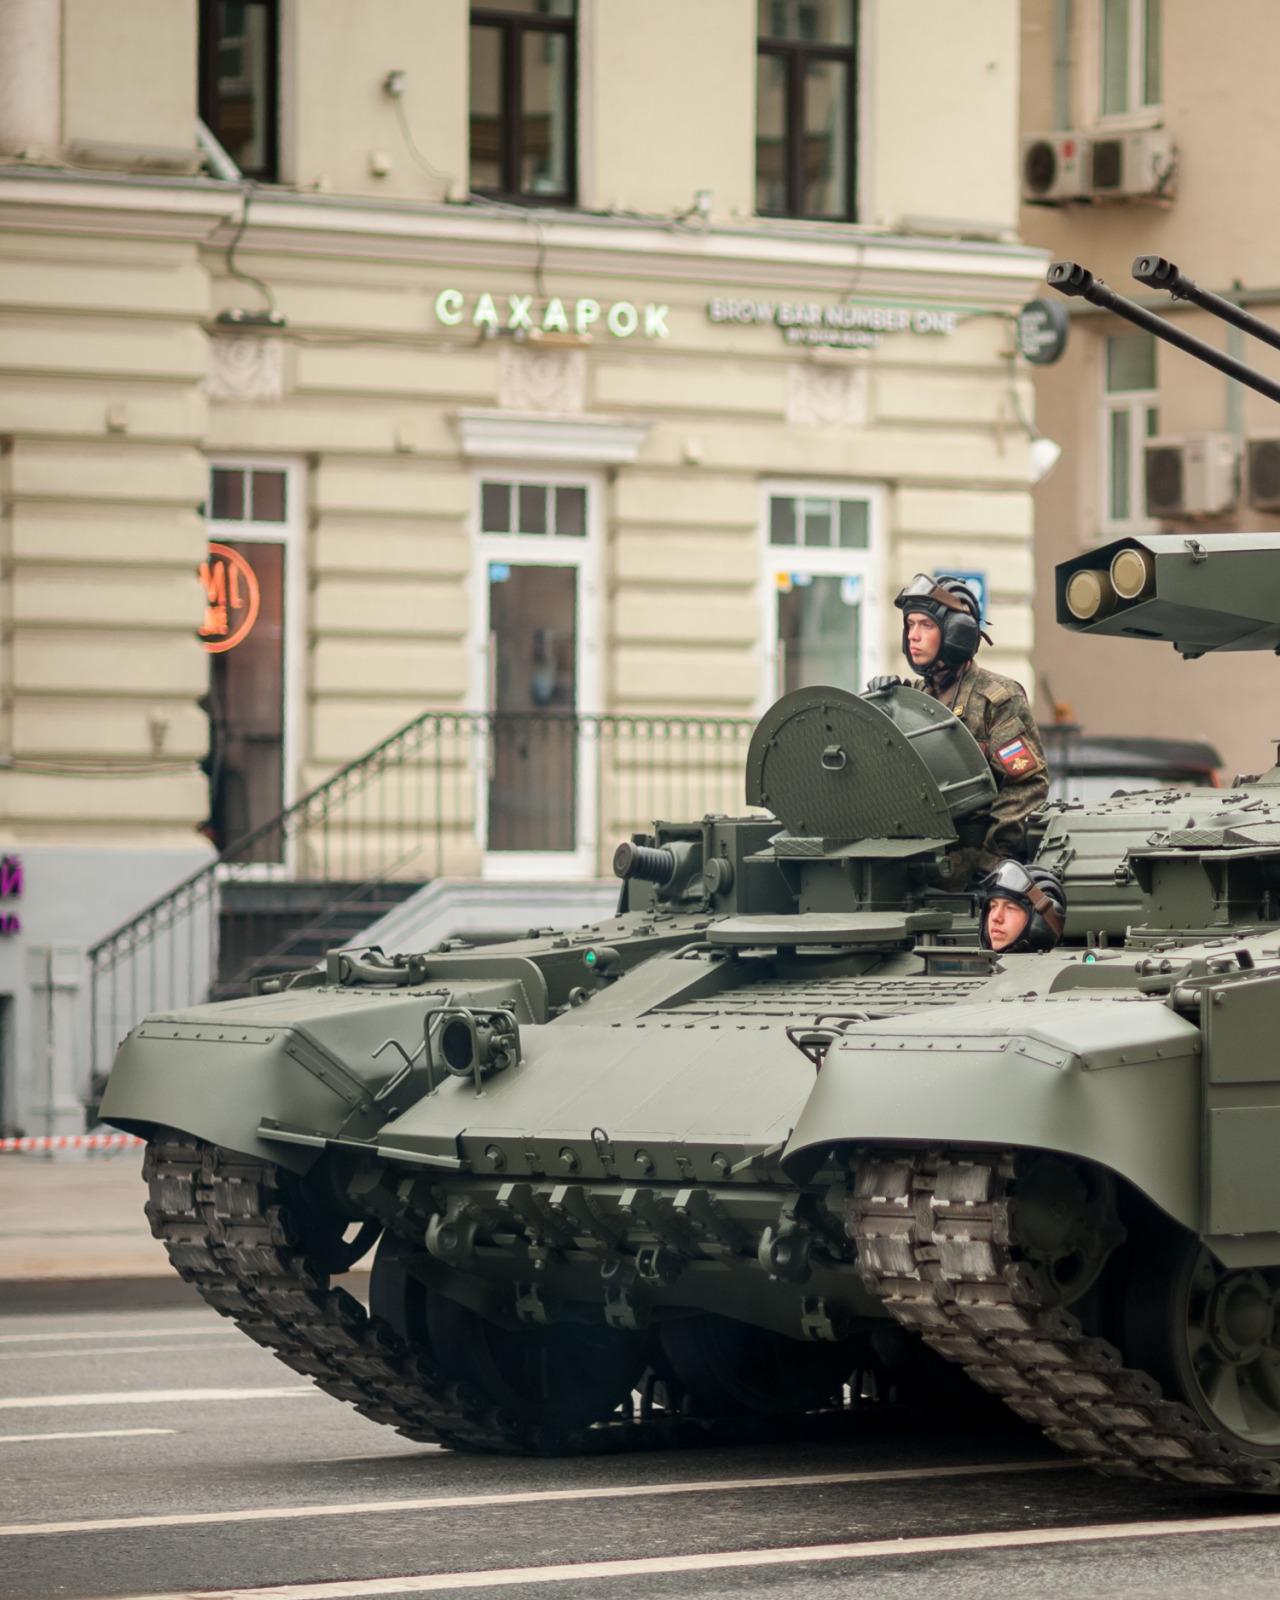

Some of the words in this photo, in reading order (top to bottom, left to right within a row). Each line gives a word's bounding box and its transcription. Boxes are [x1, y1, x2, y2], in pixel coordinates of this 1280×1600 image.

[435, 288, 670, 339] САХАРОК
[709, 298, 772, 322] BROW
[776, 303, 821, 327] BAR
[824, 306, 911, 332] NUMBER
[912, 310, 957, 334] ONE
